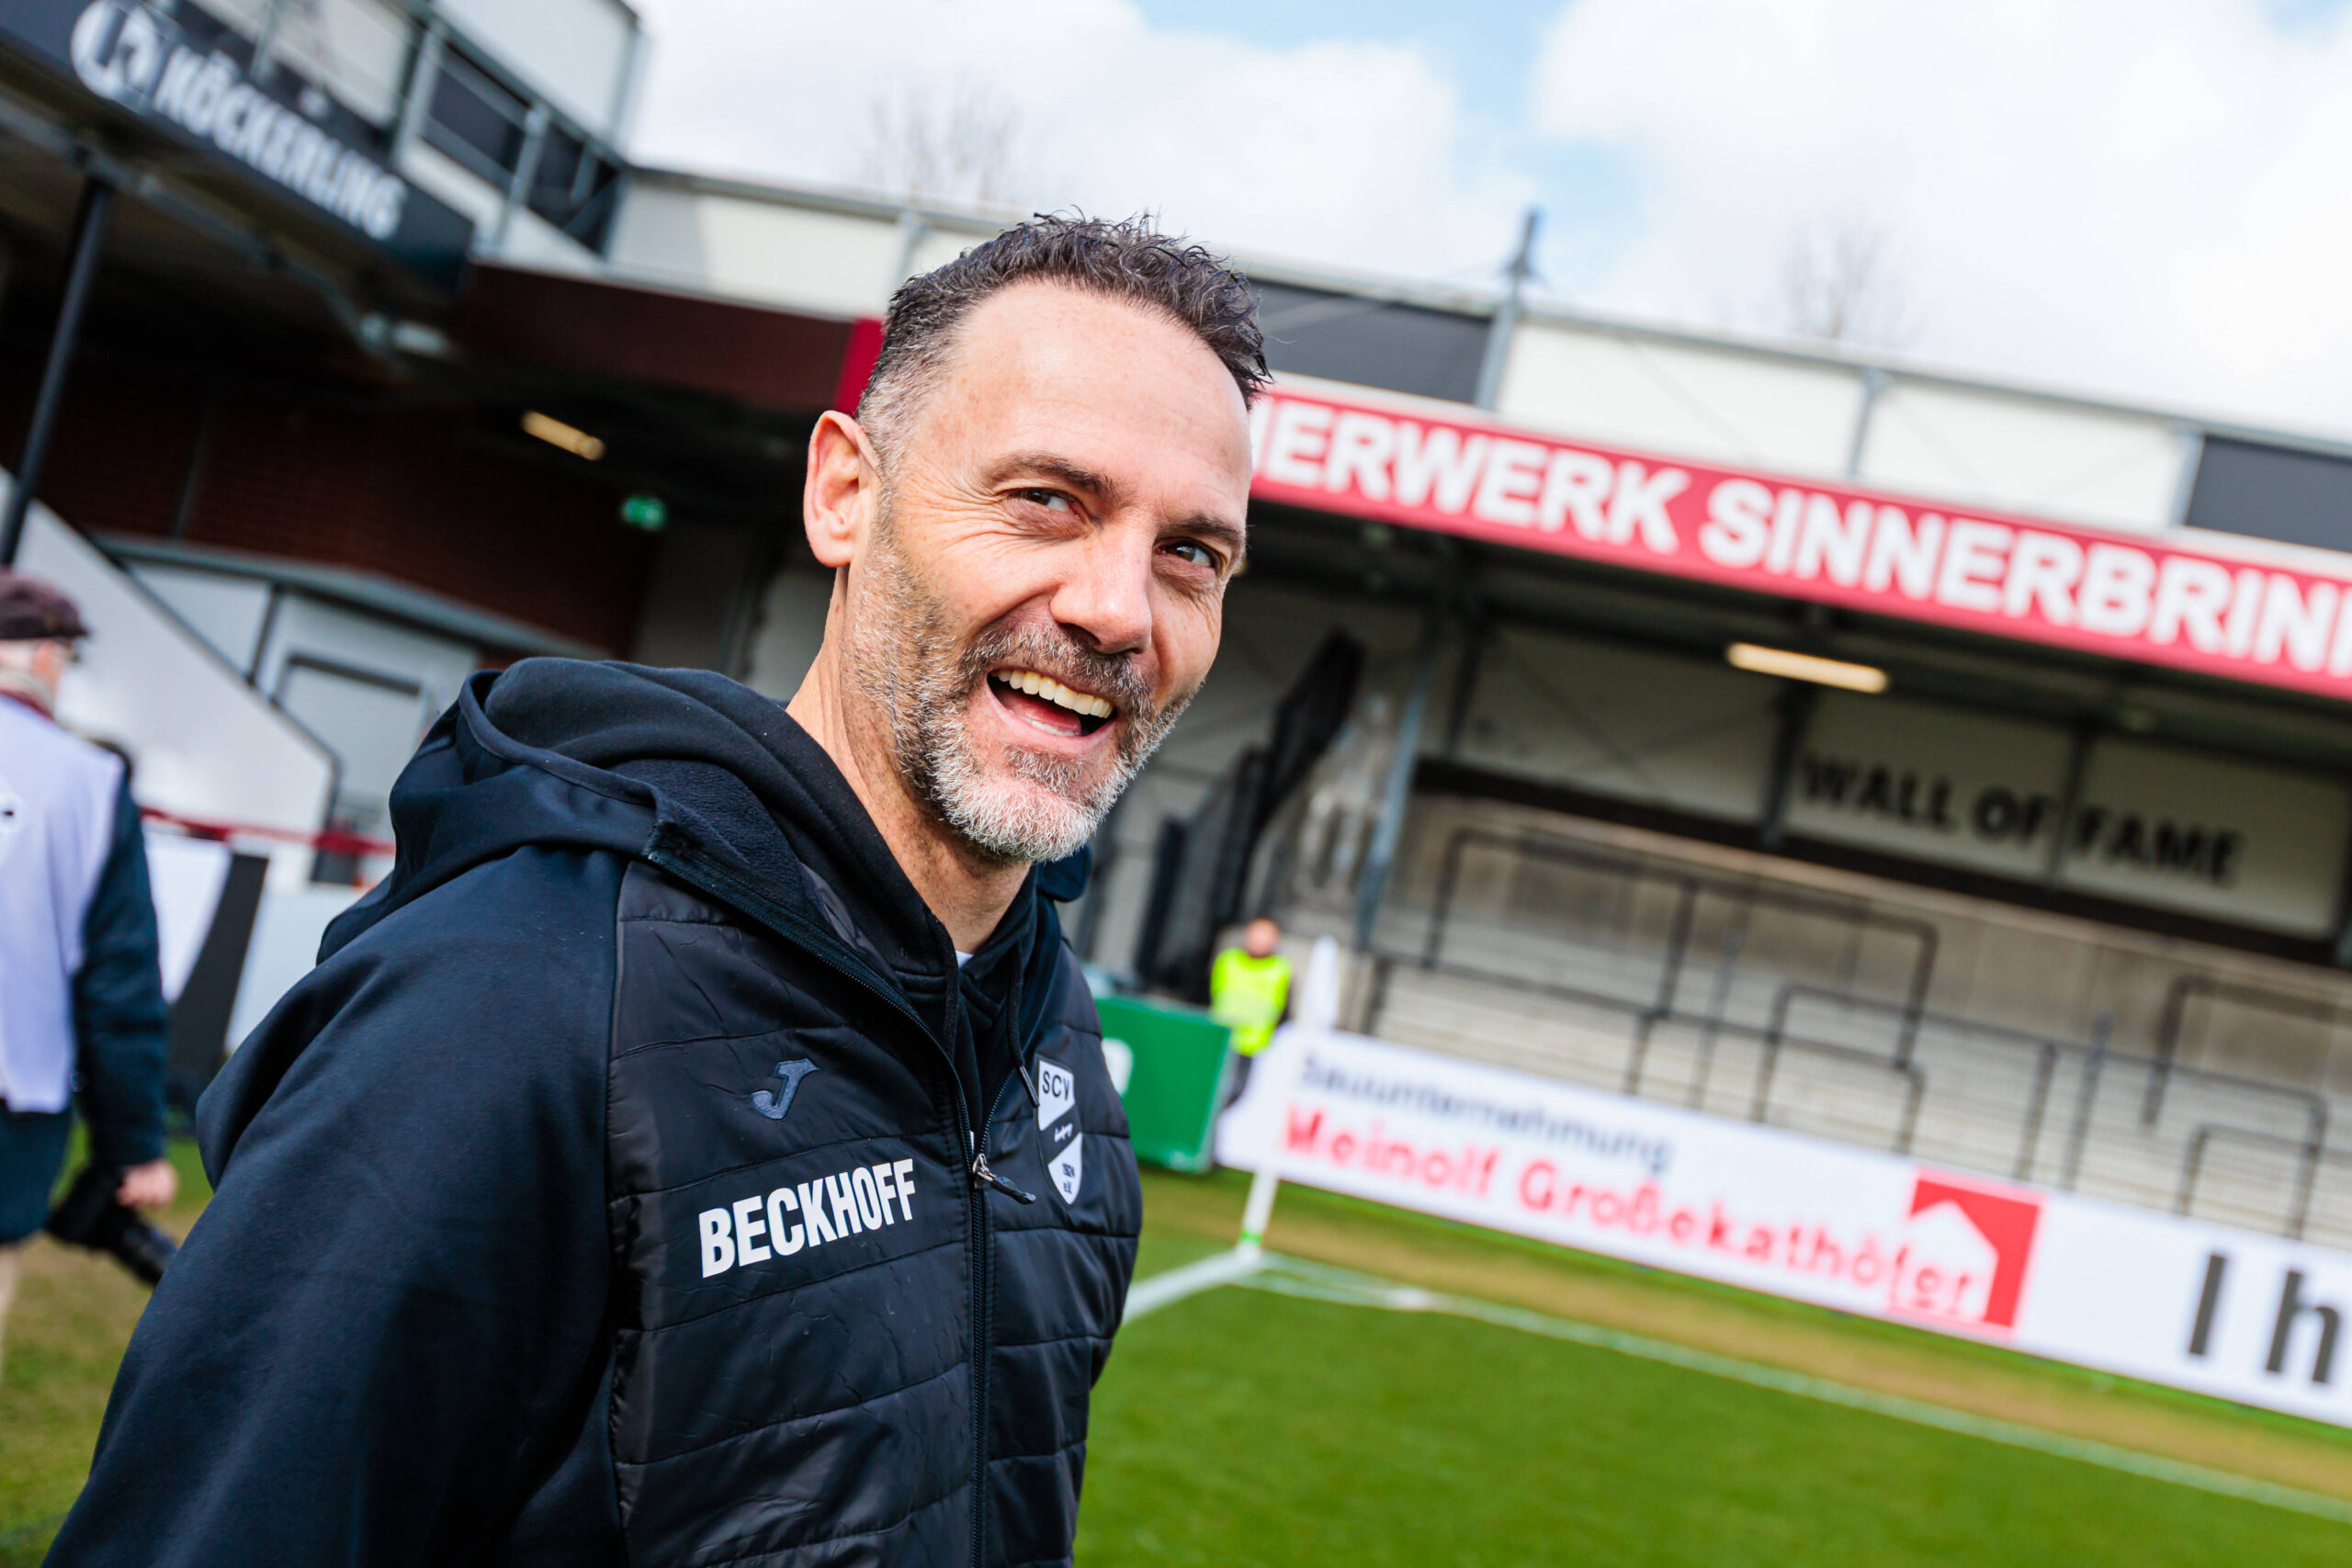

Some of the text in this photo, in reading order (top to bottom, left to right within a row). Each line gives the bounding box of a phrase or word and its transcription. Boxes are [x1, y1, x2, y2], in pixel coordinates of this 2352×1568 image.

[1250, 395, 2352, 679] ERWERK SINNERBRIN
[1804, 757, 2241, 887] WALL OF FAME
[1284, 1105, 1499, 1196] Meinolf
[698, 1157, 916, 1279] BECKHOFF
